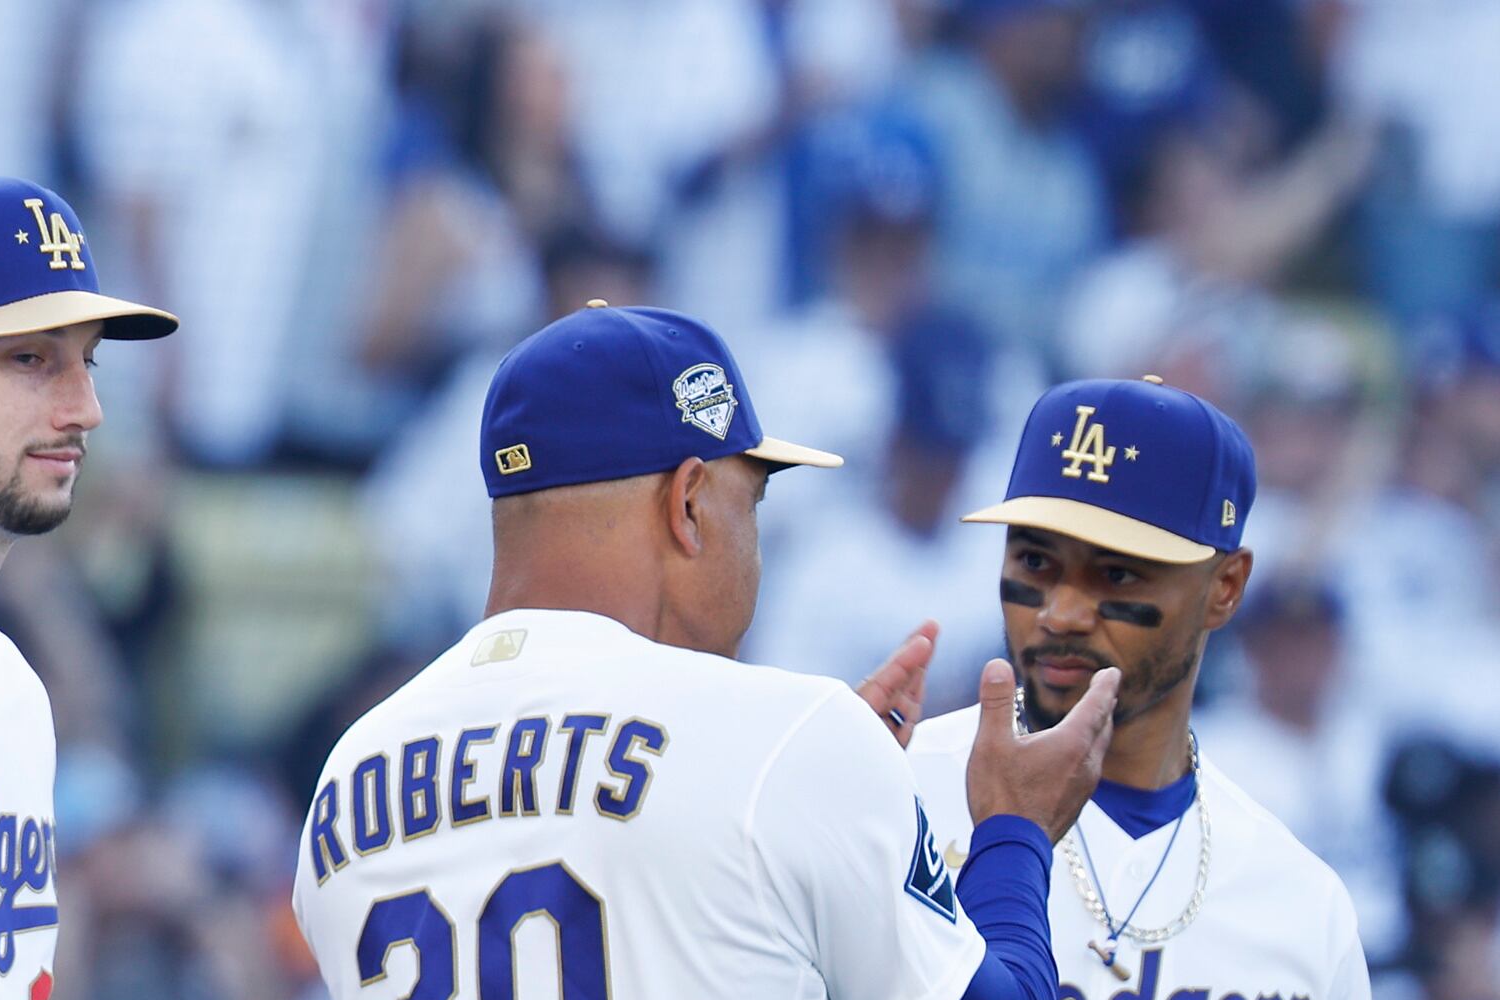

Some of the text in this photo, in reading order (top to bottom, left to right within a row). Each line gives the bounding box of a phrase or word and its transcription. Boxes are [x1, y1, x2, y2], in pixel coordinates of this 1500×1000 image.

[23, 198, 85, 270] LA
[1061, 404, 1117, 483] LA
[310, 712, 670, 887] ROBERTS
